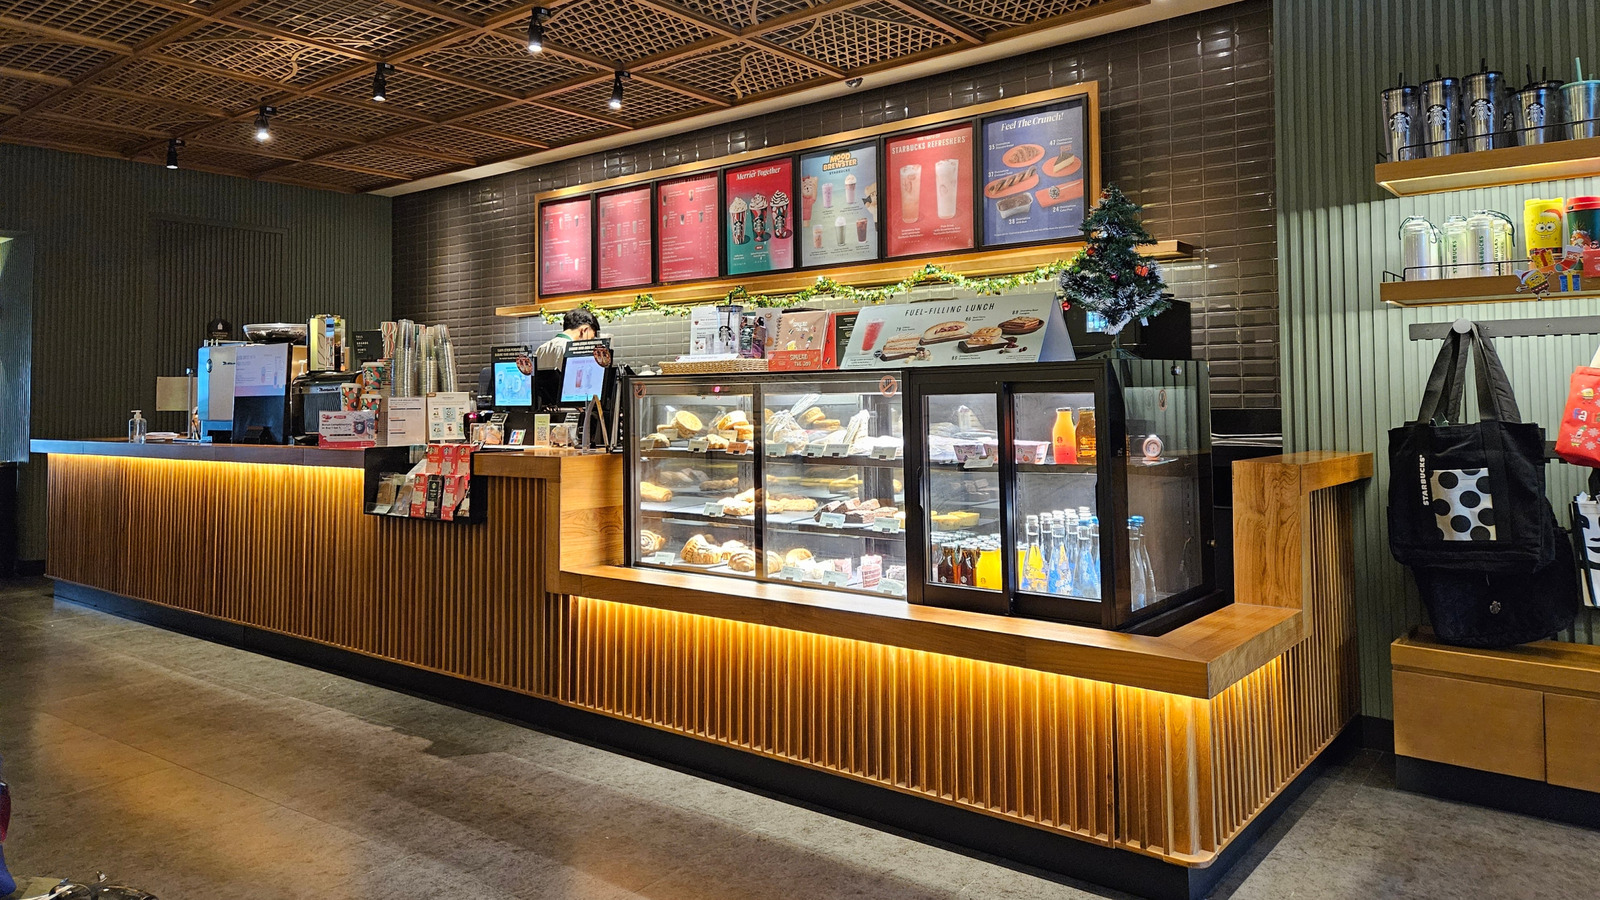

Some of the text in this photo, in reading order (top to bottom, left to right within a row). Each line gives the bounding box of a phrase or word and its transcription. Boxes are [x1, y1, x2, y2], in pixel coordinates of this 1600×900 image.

[1001, 112, 1064, 131] Feel The Crunch!
[892, 142, 926, 154] STARBUCKS
[823, 158, 857, 171] BREWSTER
[830, 152, 851, 163] MOOD
[736, 166, 781, 181] Merrier Together
[905, 302, 995, 317] FUEL-FILLING LUNCH
[1573, 407, 1588, 422] Fa
[1419, 455, 1429, 506] STARBUCKS
